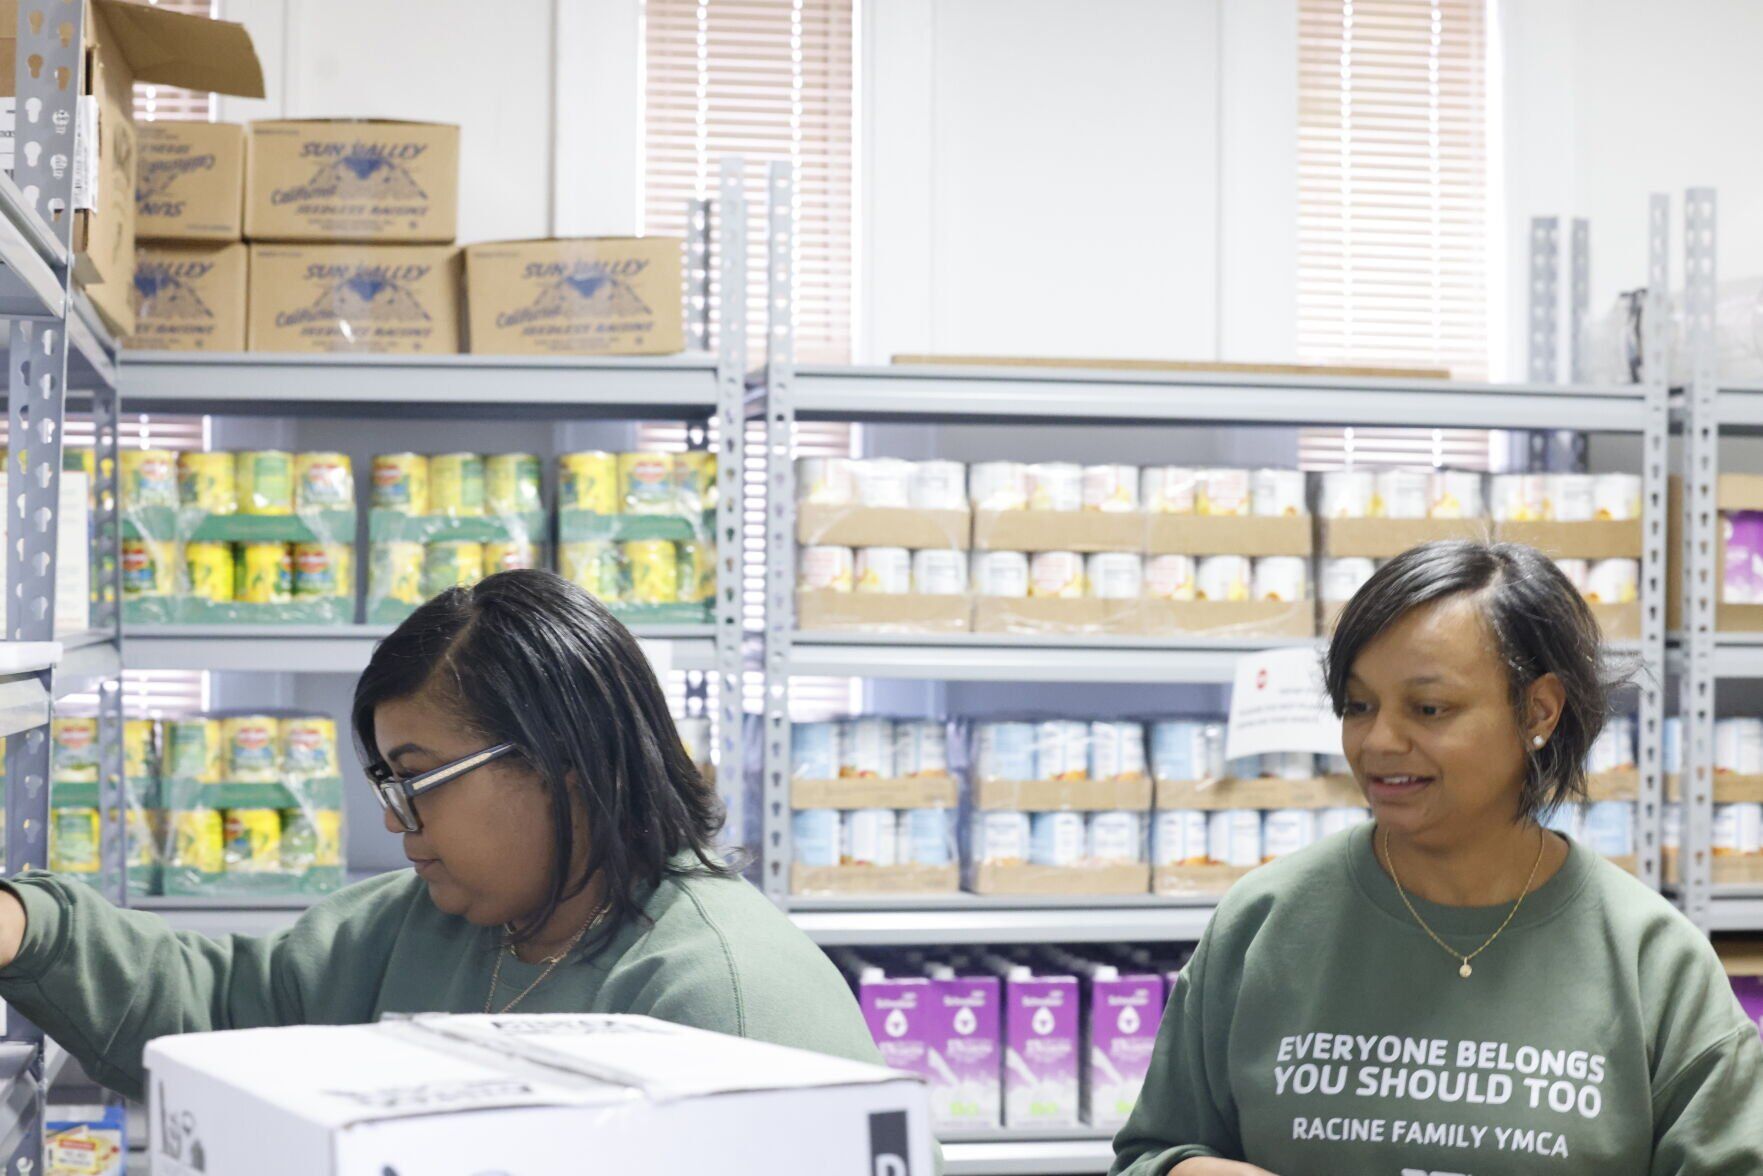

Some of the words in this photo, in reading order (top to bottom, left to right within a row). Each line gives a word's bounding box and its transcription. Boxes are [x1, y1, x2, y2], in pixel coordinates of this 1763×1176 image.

[300, 141, 346, 158] SUN
[351, 139, 428, 160] VALLEY
[303, 262, 349, 280] SUN
[353, 260, 431, 281] VALLEY
[521, 262, 565, 278] SUN
[1276, 1032, 1448, 1067] EVERYONE
[1456, 1040, 1606, 1083] BELONGS
[1273, 1063, 1348, 1095] YOU
[1355, 1066, 1513, 1105] SHOULD
[1523, 1077, 1602, 1119] TOO
[1292, 1117, 1386, 1142] RACINE
[1392, 1120, 1488, 1149] FAMILY
[1494, 1126, 1570, 1159] YMCA
